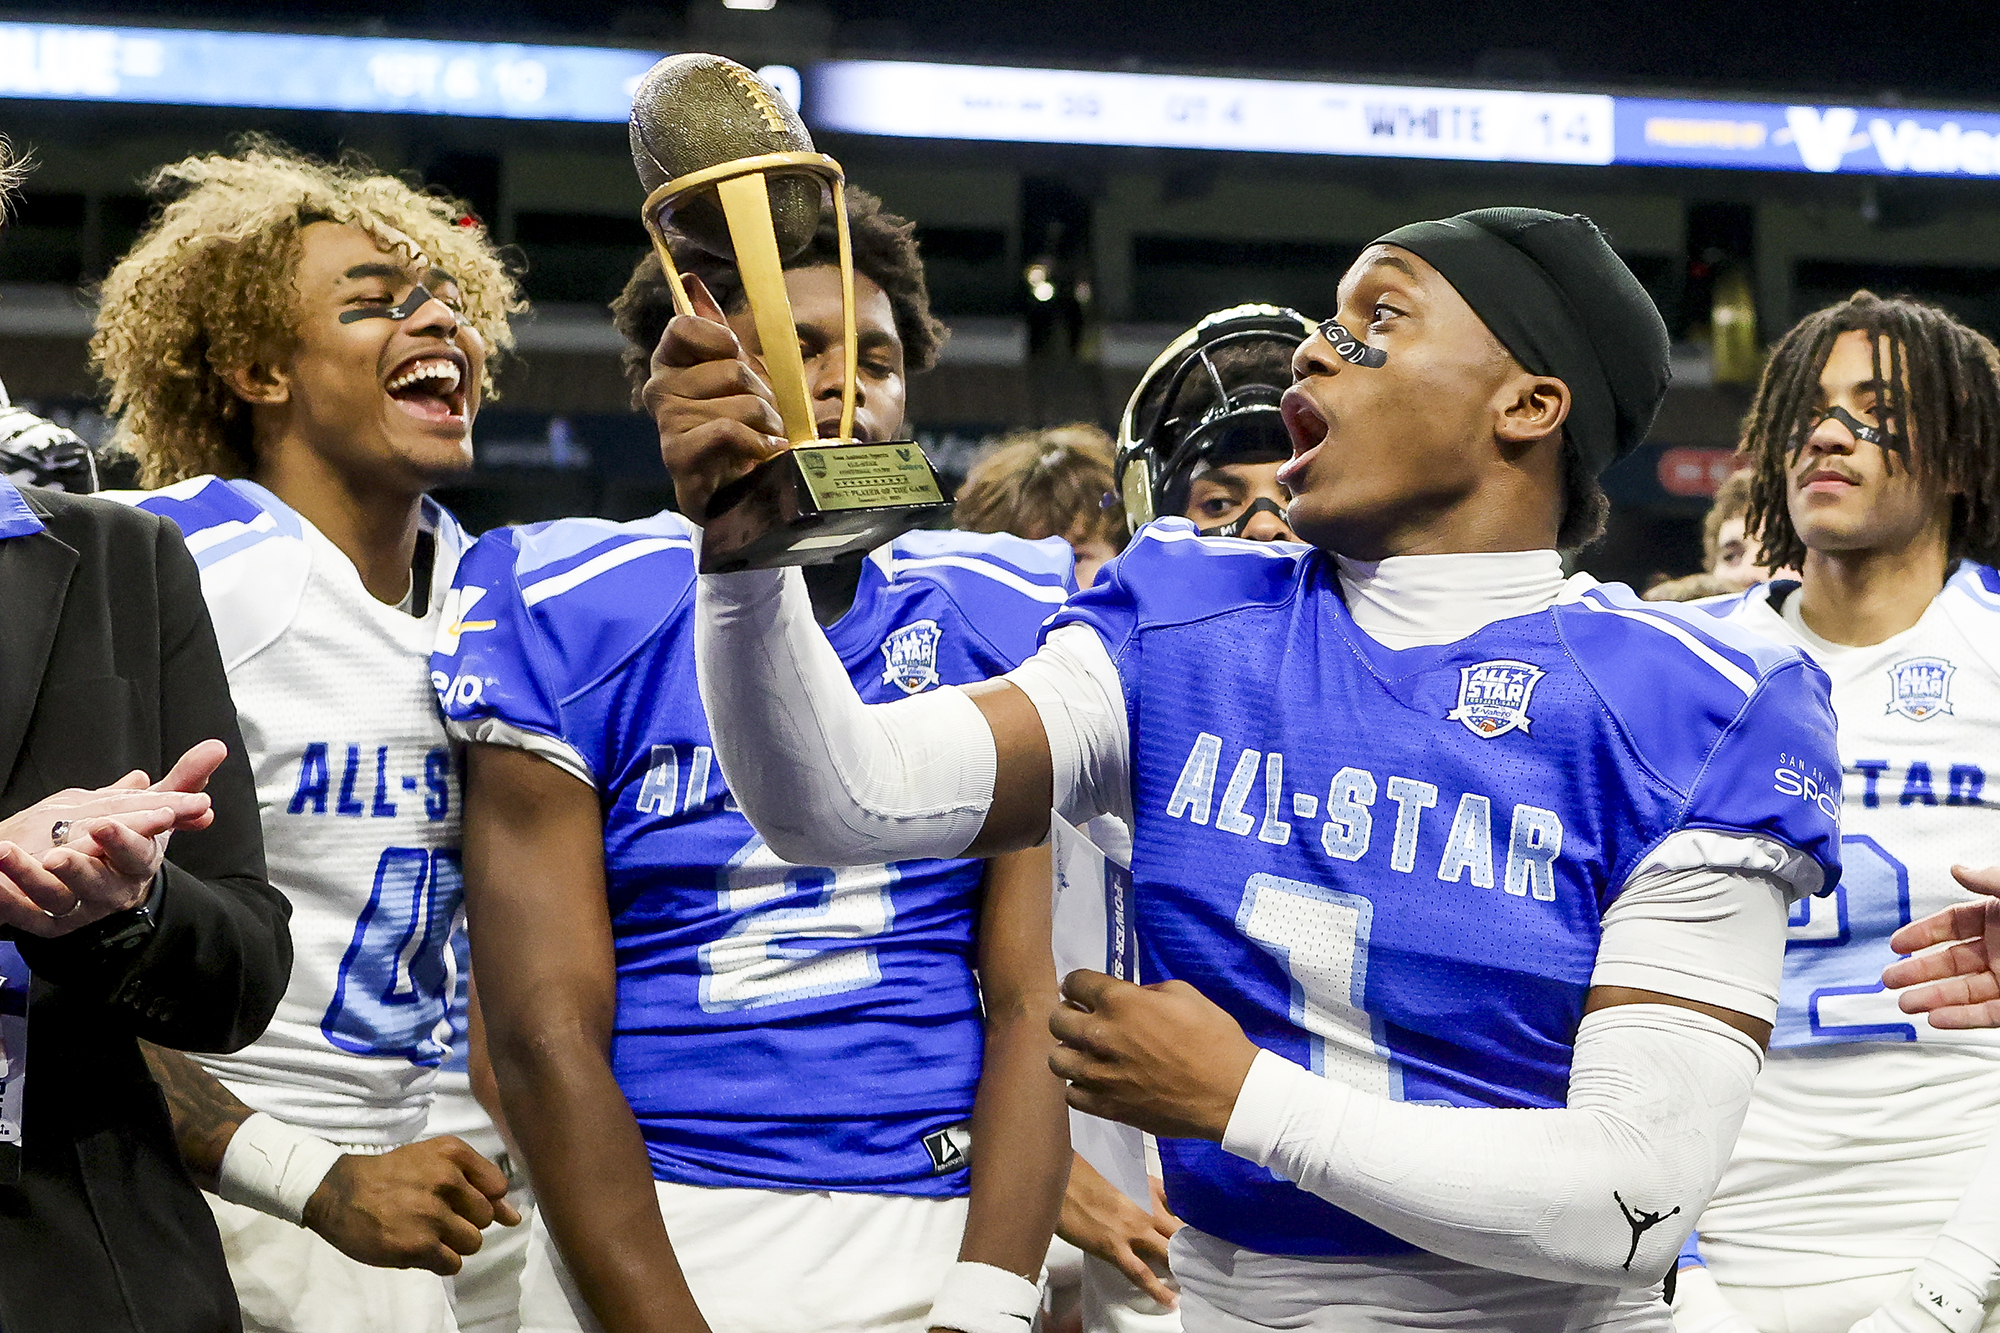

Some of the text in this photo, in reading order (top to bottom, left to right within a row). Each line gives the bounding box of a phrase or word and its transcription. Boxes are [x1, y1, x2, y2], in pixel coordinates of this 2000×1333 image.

[1364, 102, 1592, 146] WHITE 14
[1466, 681, 1524, 702] STAR
[1470, 669, 1511, 683] ALL
[1780, 752, 1805, 771] SAN
[1166, 731, 1563, 902] ALL-STAR
[698, 833, 902, 1015] 2
[1235, 872, 1455, 1108] 1
